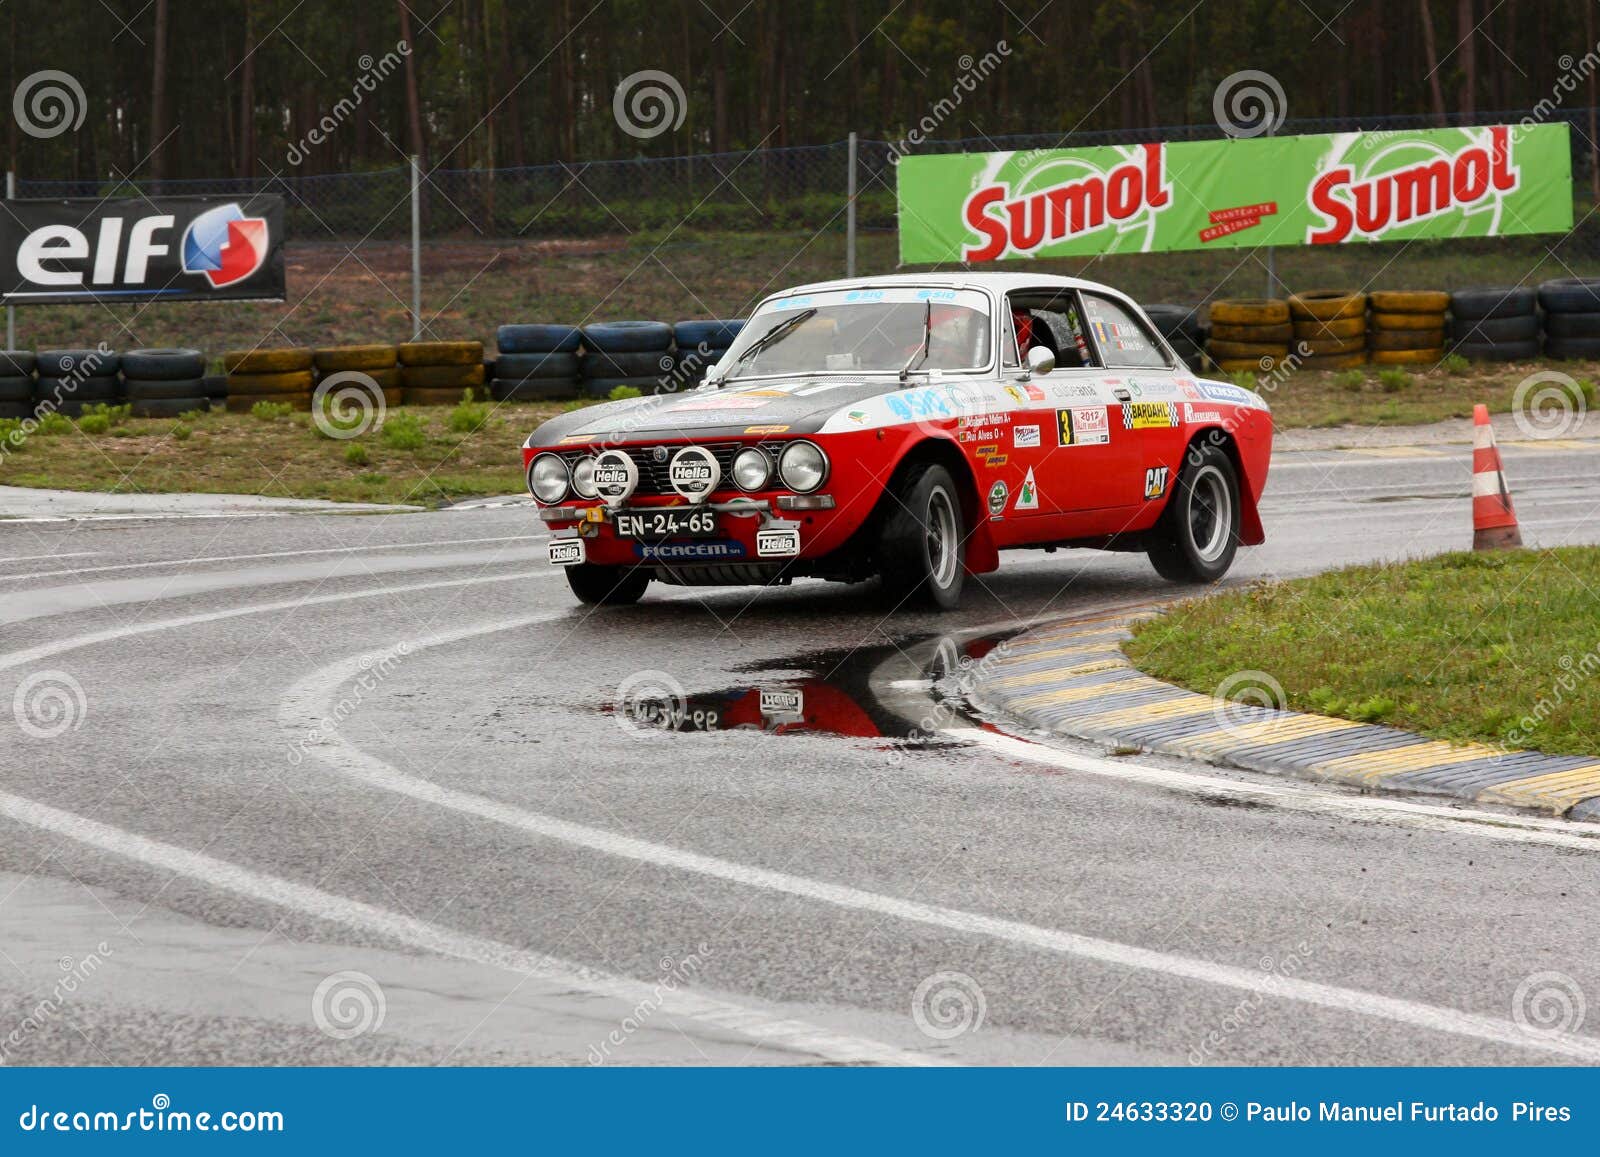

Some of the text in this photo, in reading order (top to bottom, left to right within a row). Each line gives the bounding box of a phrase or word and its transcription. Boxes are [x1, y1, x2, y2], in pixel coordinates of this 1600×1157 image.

[1312, 127, 1515, 245] Sumol
[967, 143, 1168, 262] Sumol
[16, 215, 175, 285] elf
[1132, 403, 1169, 422] BARDAHL
[978, 429, 993, 440] Alves
[1061, 411, 1071, 444] 3
[1080, 411, 1099, 421] 2012
[596, 470, 626, 482] Hella
[675, 467, 709, 478] Hella
[1145, 467, 1168, 497] CAT
[618, 512, 715, 536] EN-24-65
[552, 547, 579, 559] Hella
[761, 537, 793, 550] Hella
